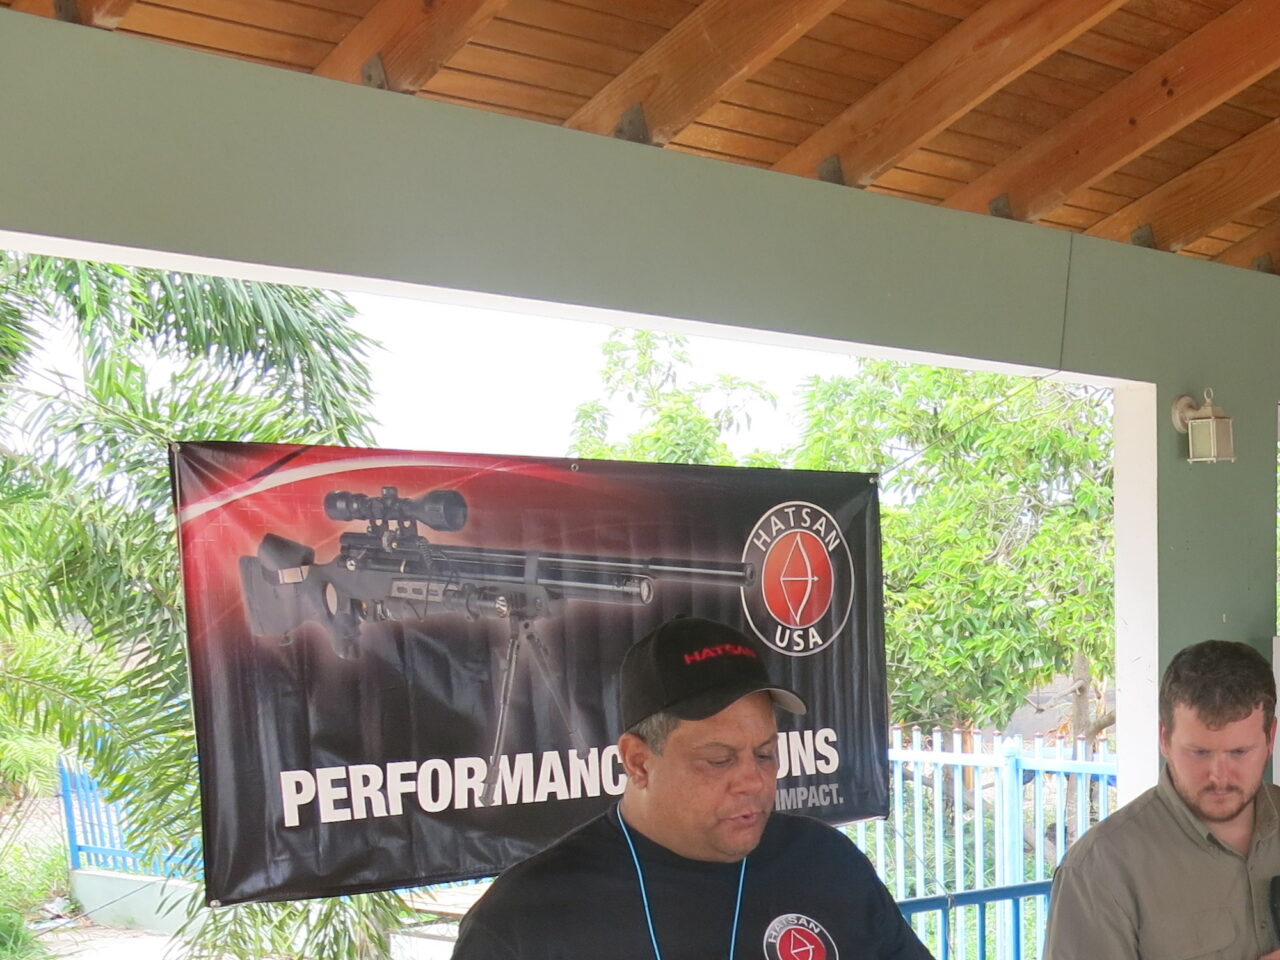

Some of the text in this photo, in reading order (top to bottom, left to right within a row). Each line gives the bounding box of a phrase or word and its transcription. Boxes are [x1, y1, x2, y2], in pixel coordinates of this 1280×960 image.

[753, 507, 841, 552] HATSAN
[775, 624, 823, 651] USA
[280, 744, 627, 828] PERFORMANC
